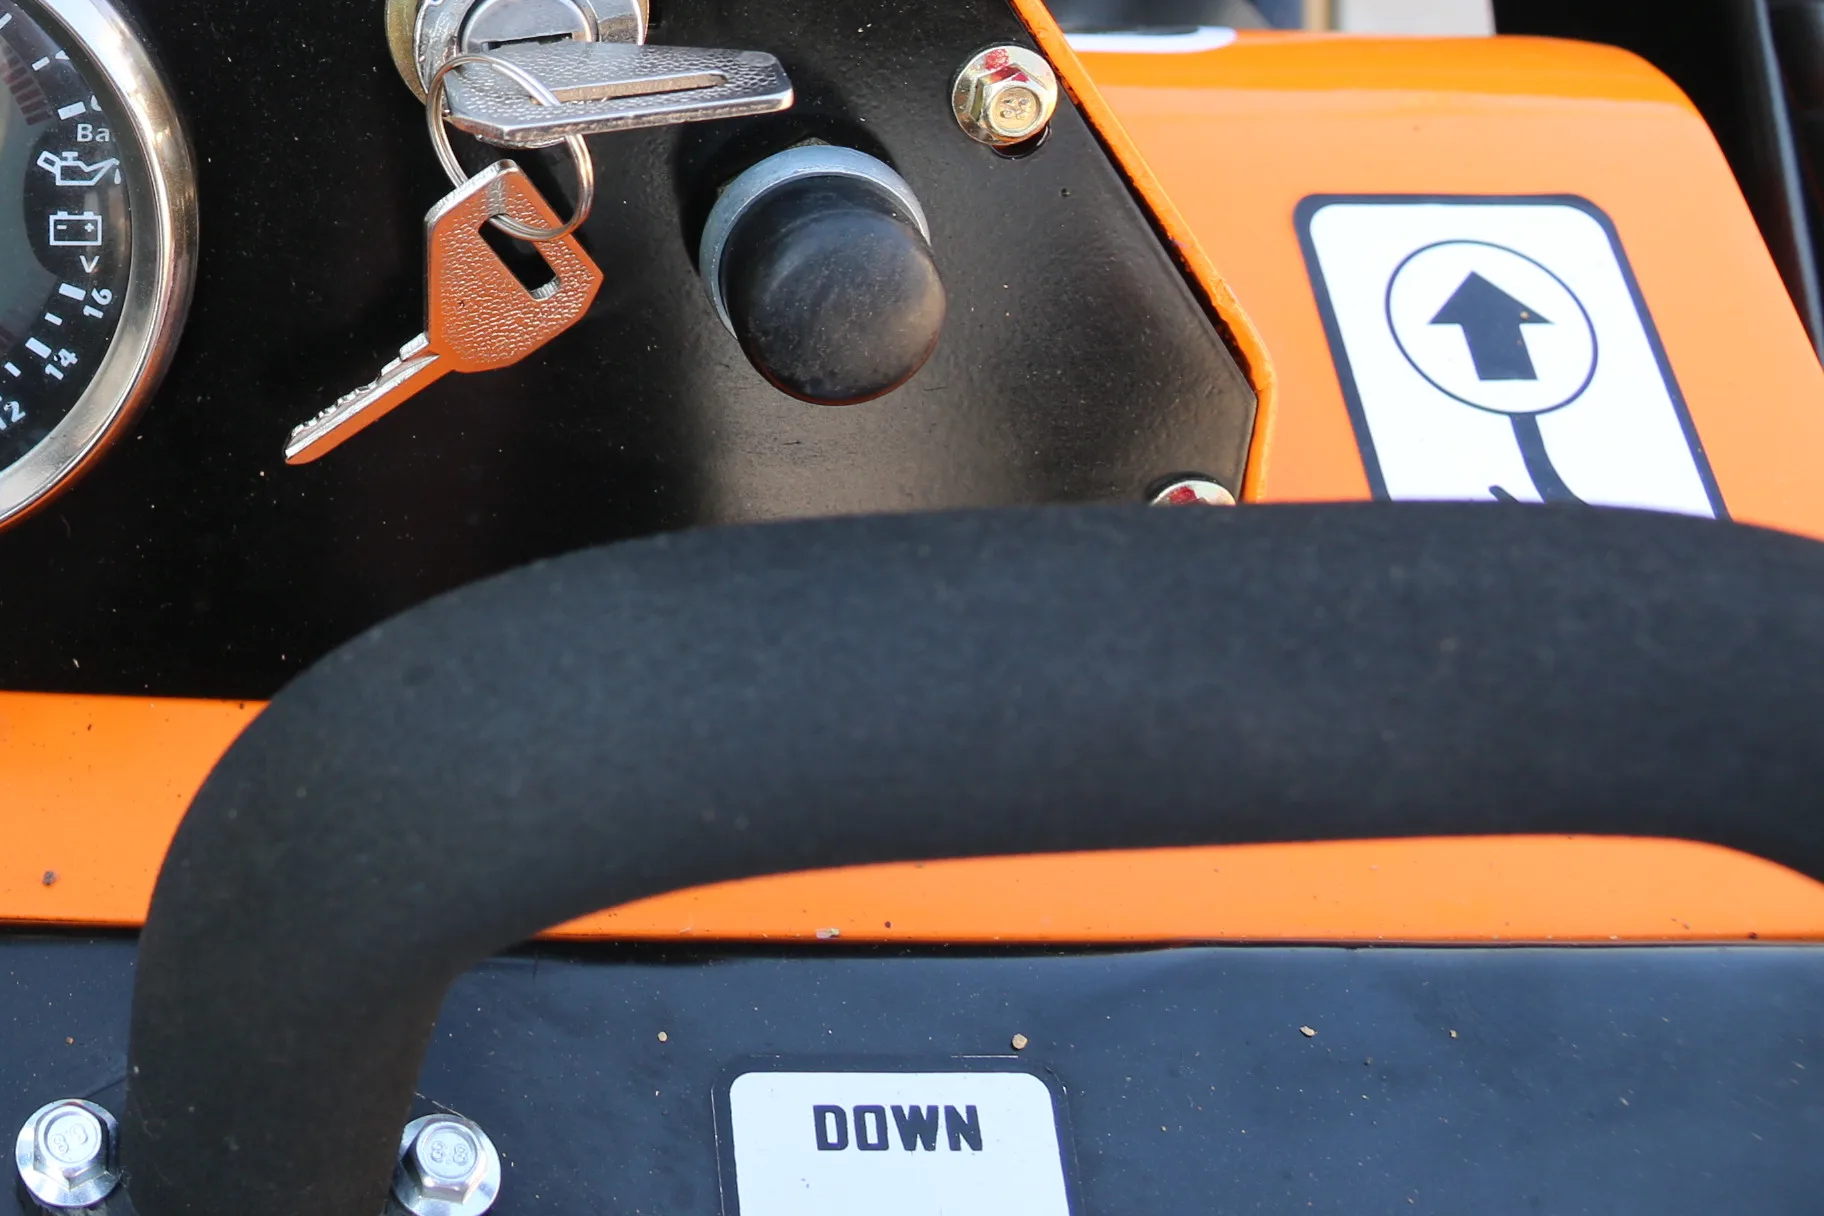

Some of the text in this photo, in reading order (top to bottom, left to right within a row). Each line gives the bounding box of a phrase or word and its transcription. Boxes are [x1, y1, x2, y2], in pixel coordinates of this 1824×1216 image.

[79, 255, 100, 273] V
[83, 288, 113, 319] 16
[44, 348, 78, 381] 14
[812, 1104, 983, 1152] DOWN
